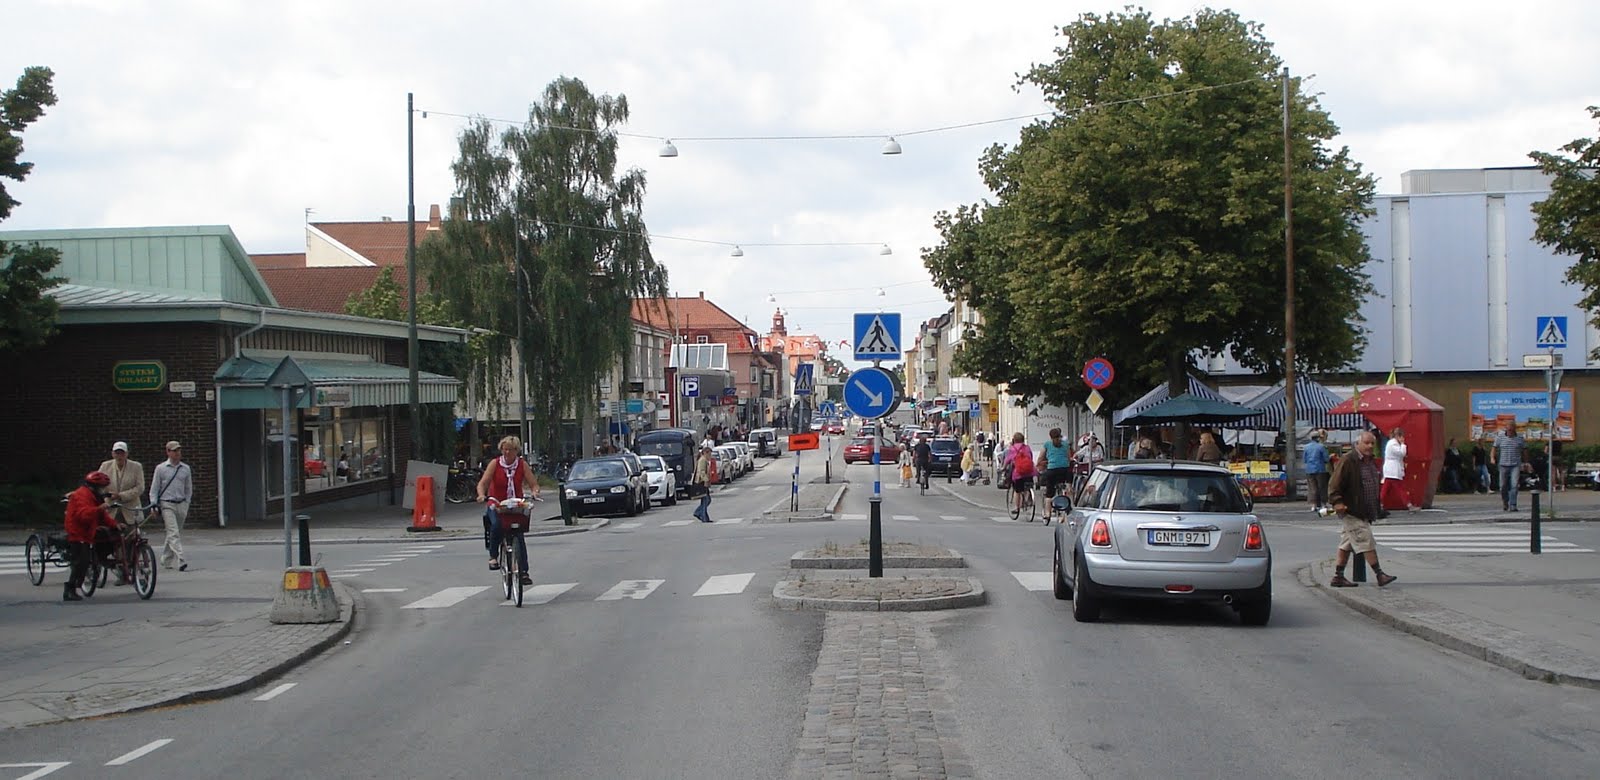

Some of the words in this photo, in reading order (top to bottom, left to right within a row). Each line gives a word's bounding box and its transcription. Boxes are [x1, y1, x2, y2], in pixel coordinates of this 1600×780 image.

[120, 368, 155, 376] SYSTEM
[117, 376, 158, 384] BOLAGET
[684, 381, 698, 396] P
[1155, 532, 1177, 542] GNM
[1185, 532, 1206, 543] 971
